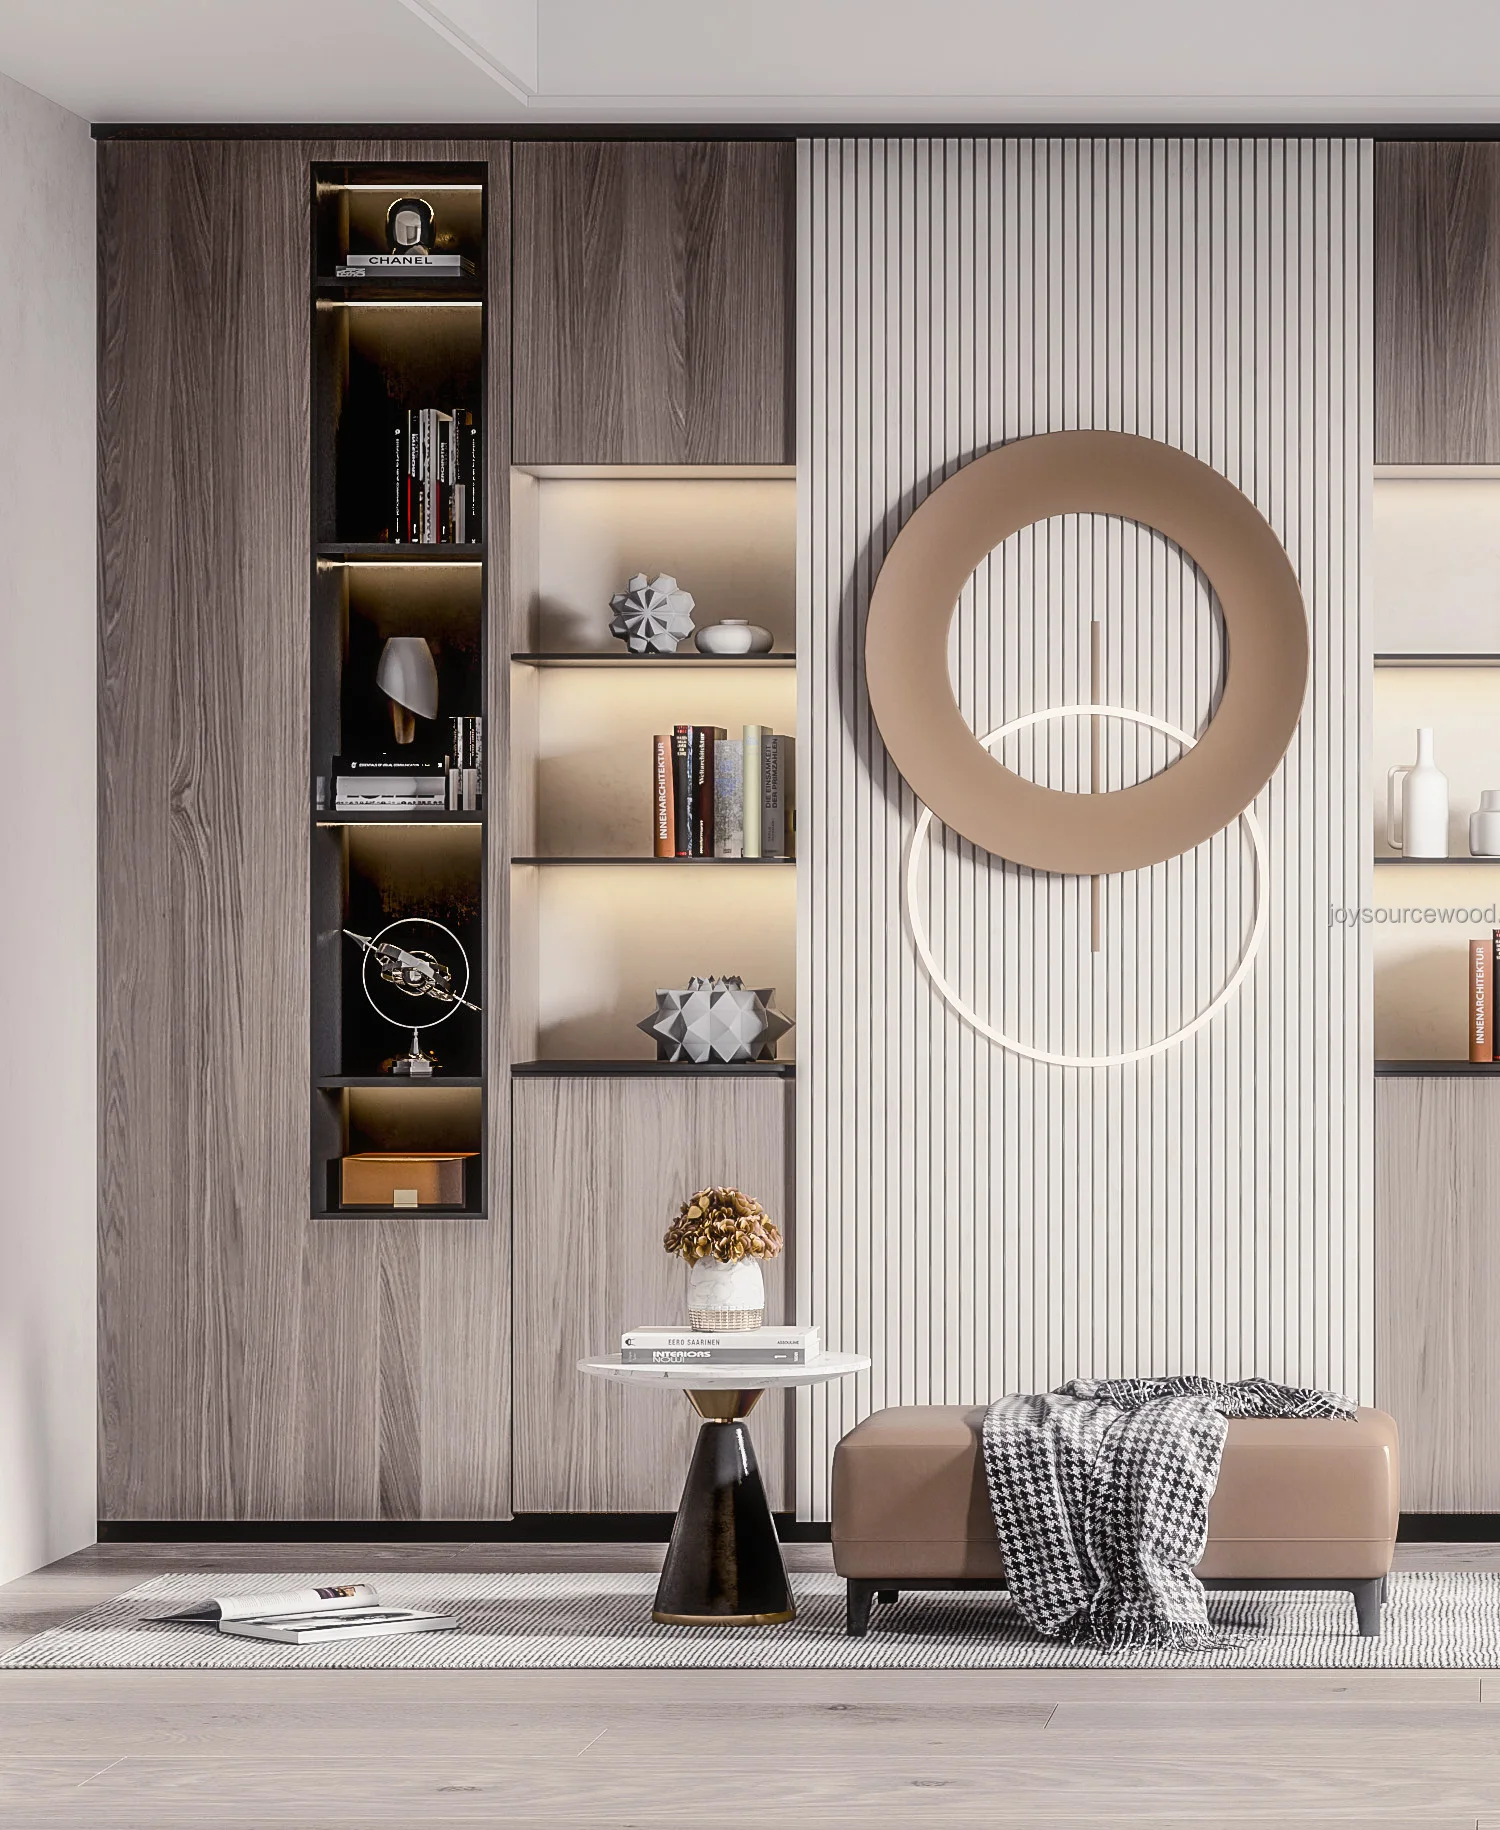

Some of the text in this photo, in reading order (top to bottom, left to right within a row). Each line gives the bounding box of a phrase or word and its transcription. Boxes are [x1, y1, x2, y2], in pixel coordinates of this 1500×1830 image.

[368, 257, 433, 265] CHANEL
[658, 742, 668, 840] INNENARCHITEKTUR
[1475, 946, 1484, 1044] INNENARCHITEKTUR
[668, 1338, 720, 1346] EERO SAARINEN
